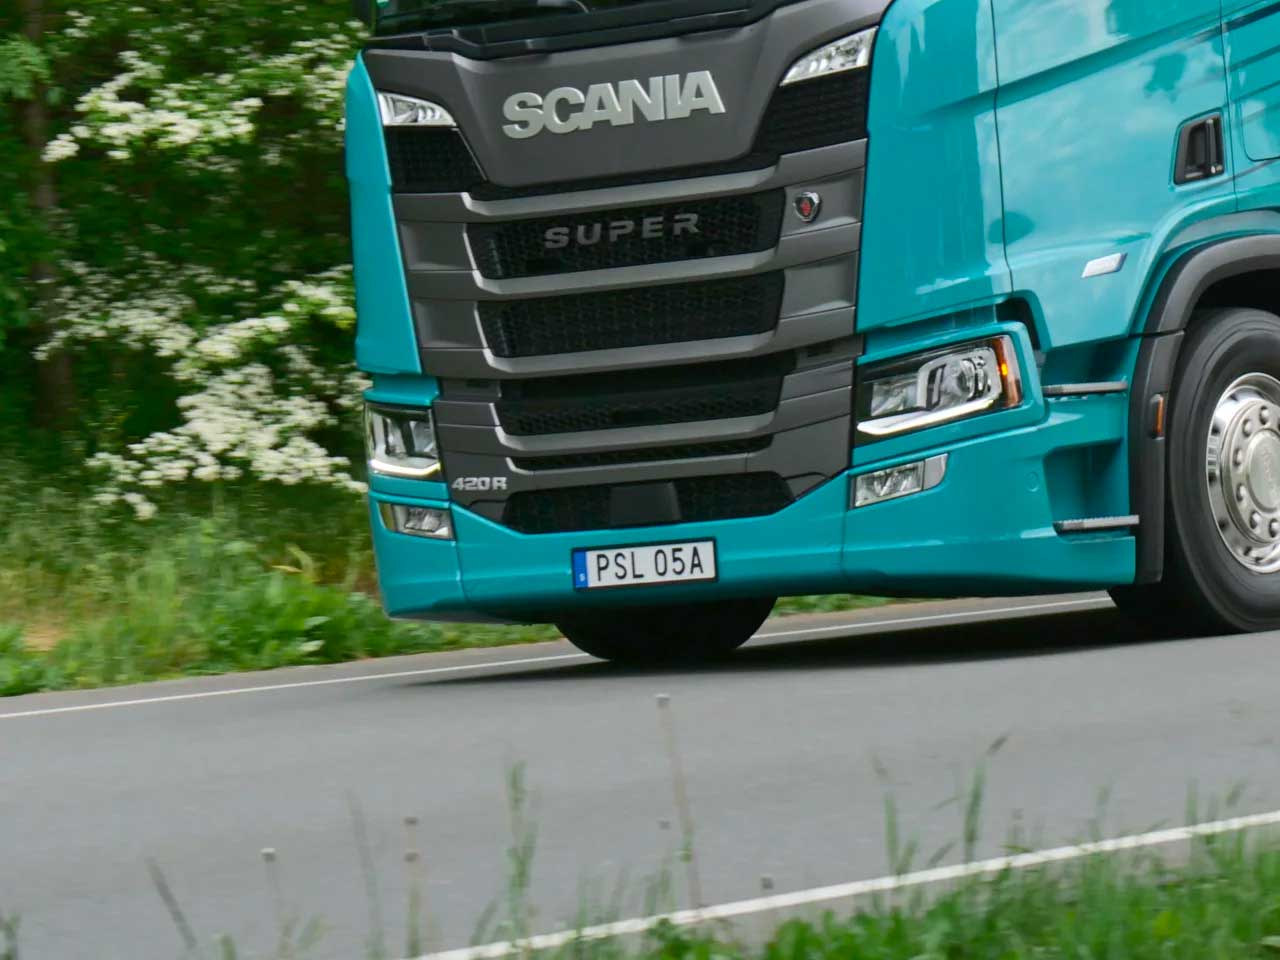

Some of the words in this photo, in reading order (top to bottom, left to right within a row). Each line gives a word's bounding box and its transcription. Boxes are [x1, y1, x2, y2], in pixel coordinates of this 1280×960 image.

[502, 70, 726, 139] SCANIA
[544, 212, 701, 249] SUPER
[596, 551, 644, 581] PSL
